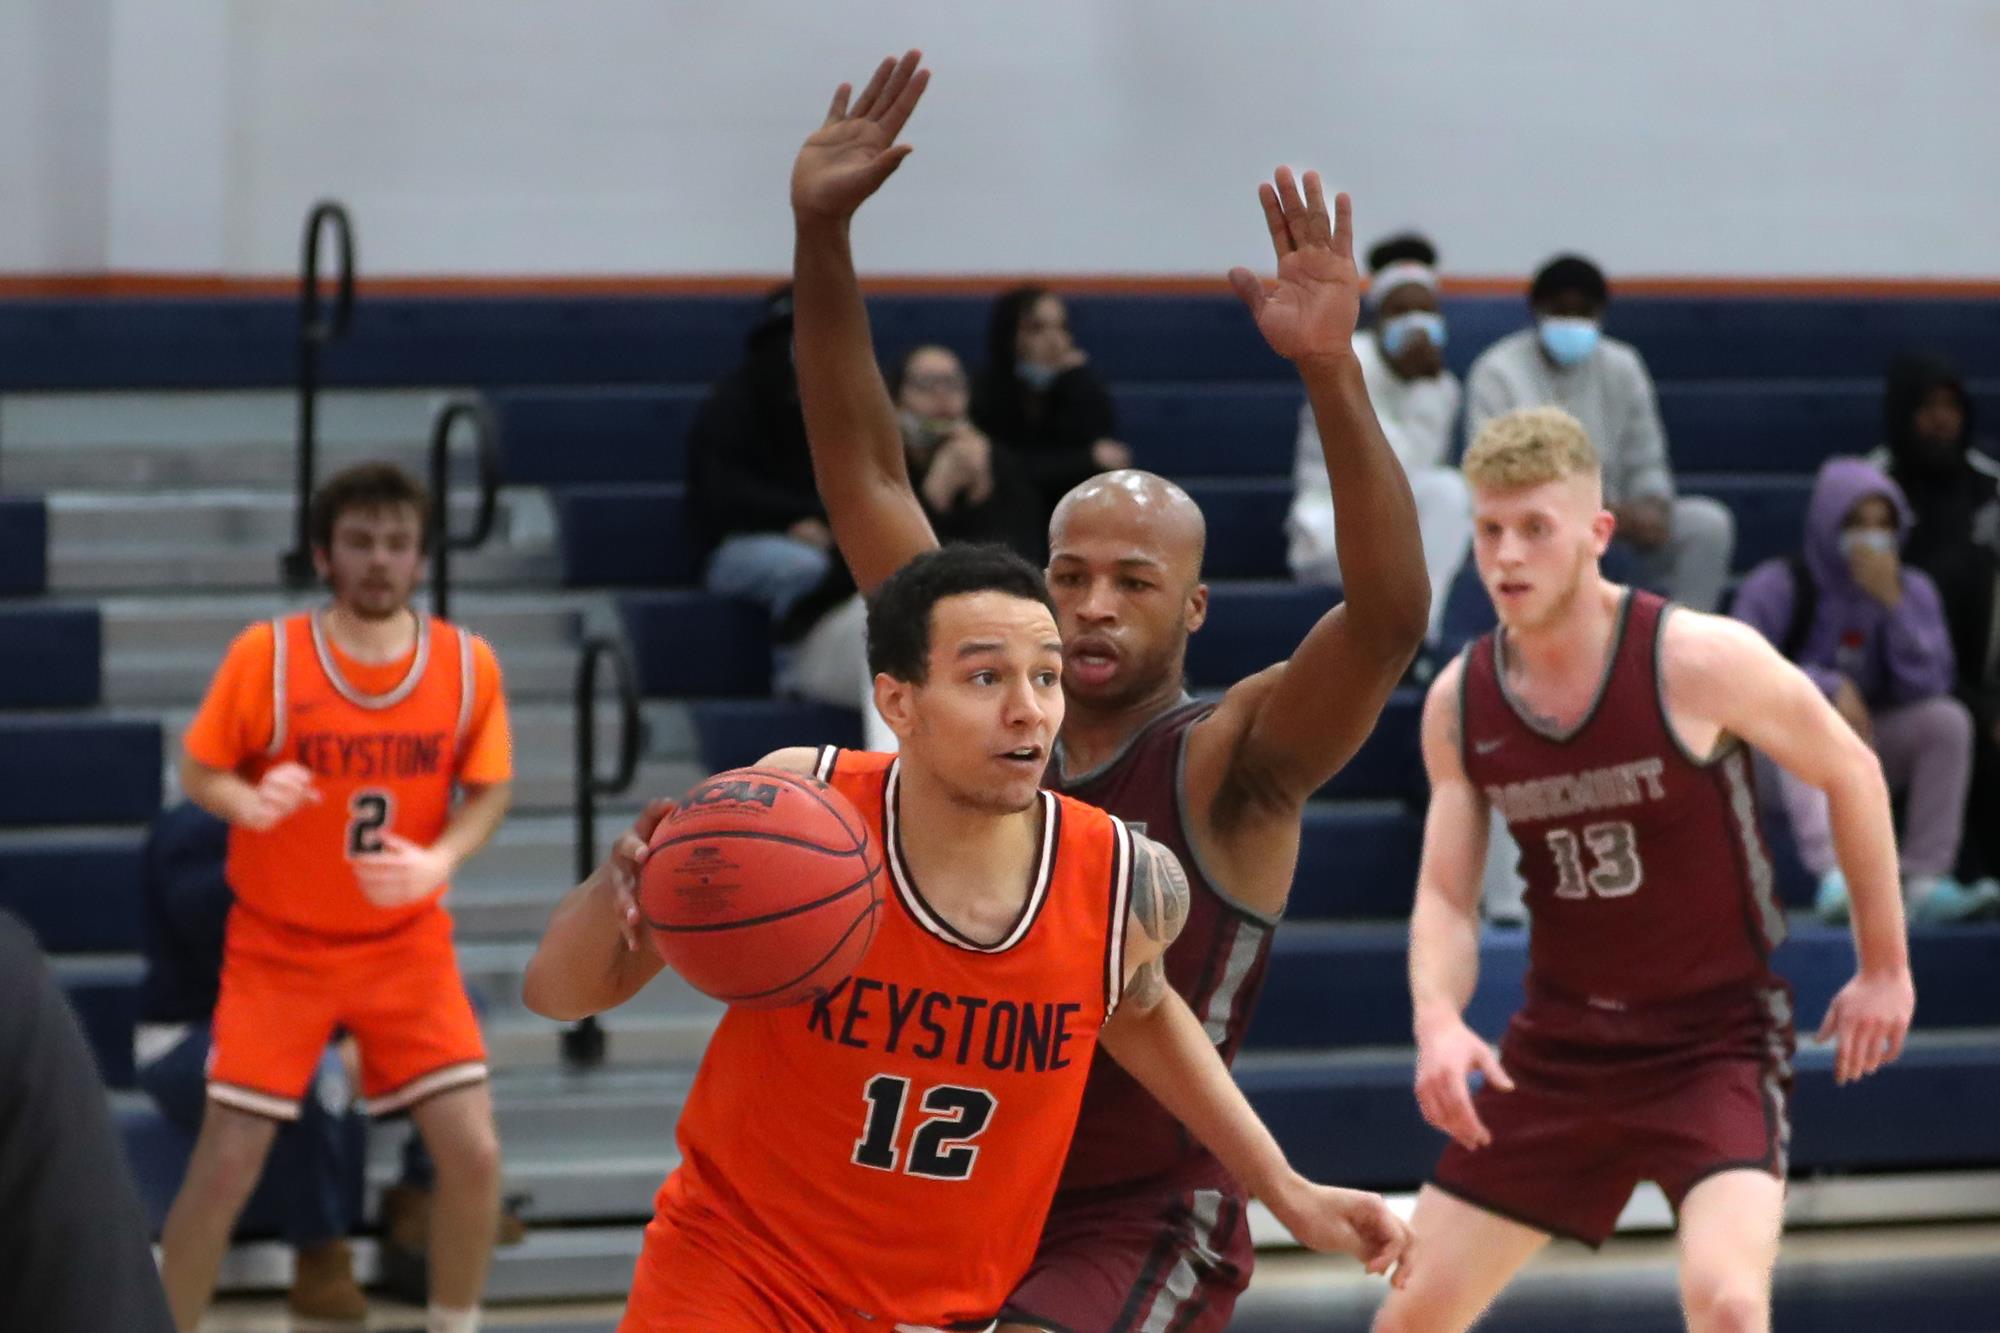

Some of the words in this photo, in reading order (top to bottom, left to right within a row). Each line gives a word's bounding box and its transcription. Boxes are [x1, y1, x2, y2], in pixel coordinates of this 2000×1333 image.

[346, 787, 394, 859] 2
[1545, 821, 1643, 899] 13
[807, 976, 1081, 1073] KEYSTONE
[850, 1073, 998, 1181] 12
